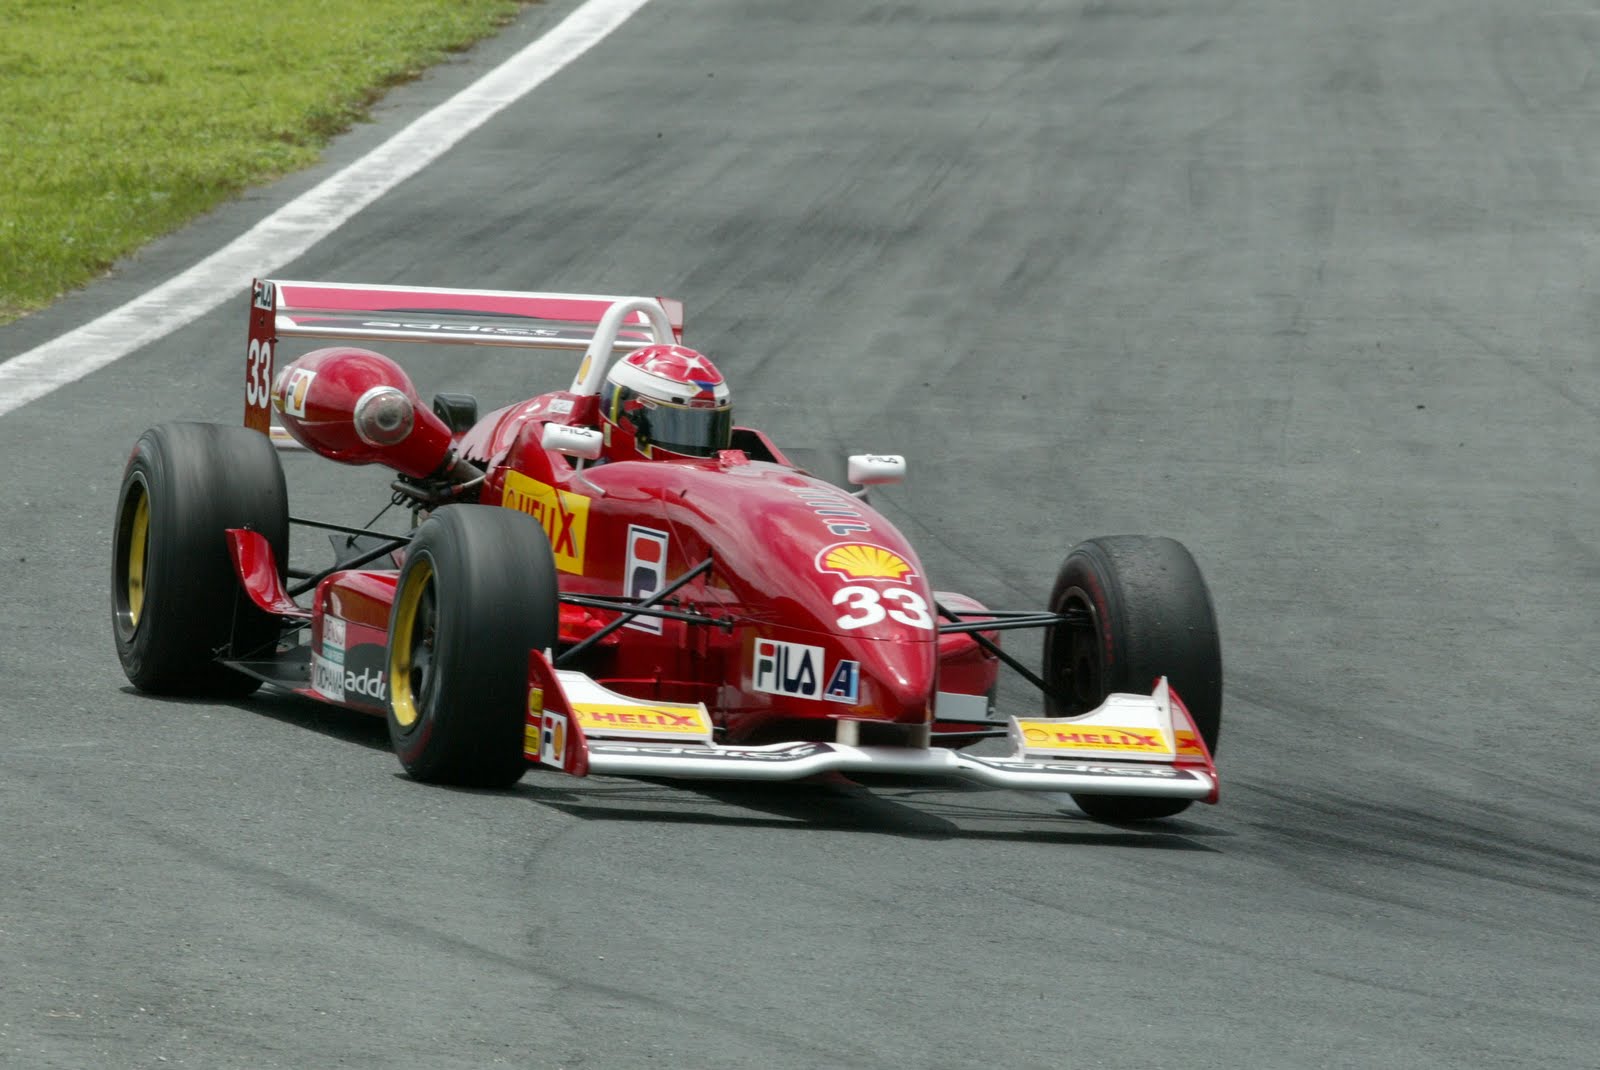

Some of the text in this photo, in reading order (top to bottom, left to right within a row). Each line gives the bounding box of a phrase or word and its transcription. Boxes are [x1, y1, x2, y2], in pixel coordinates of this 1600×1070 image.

[247, 338, 271, 409] 33
[559, 427, 593, 438] FILA
[832, 585, 934, 630] 33
[757, 643, 817, 696] FILA
[590, 710, 698, 727] HELIX
[1056, 731, 1162, 747] HELIX
